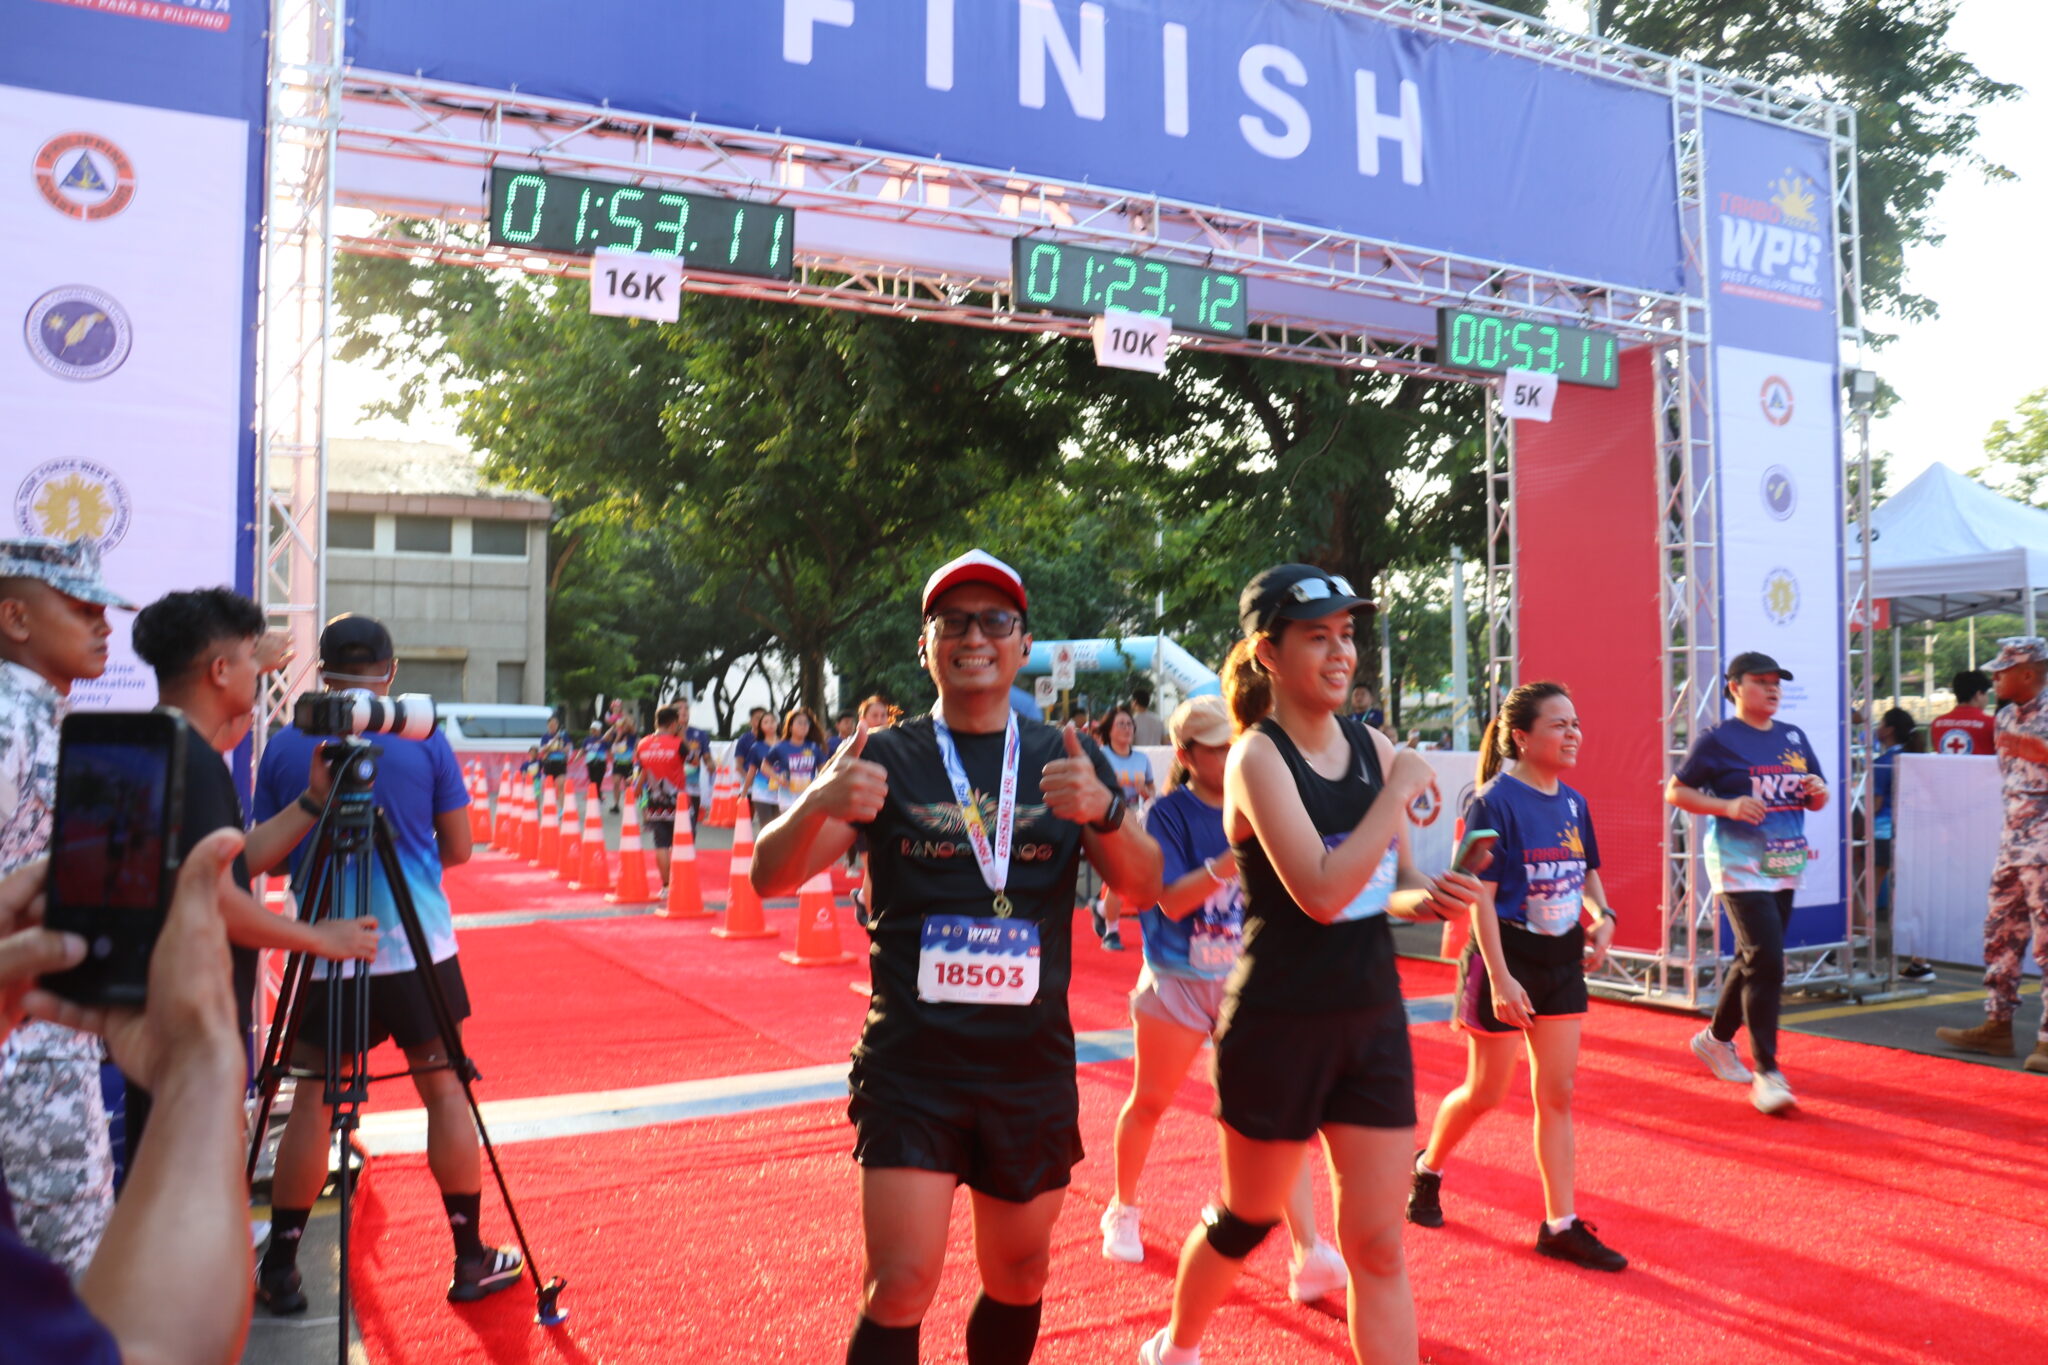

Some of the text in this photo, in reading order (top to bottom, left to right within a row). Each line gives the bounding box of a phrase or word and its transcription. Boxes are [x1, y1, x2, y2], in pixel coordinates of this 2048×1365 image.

[163, 6, 225, 29] PILIPINO
[783, 0, 1422, 186] FINISH
[605, 269, 668, 303] 16K
[1111, 327, 1158, 357] 10K
[1514, 385, 1543, 408] 5K
[935, 962, 1024, 988] 18503
